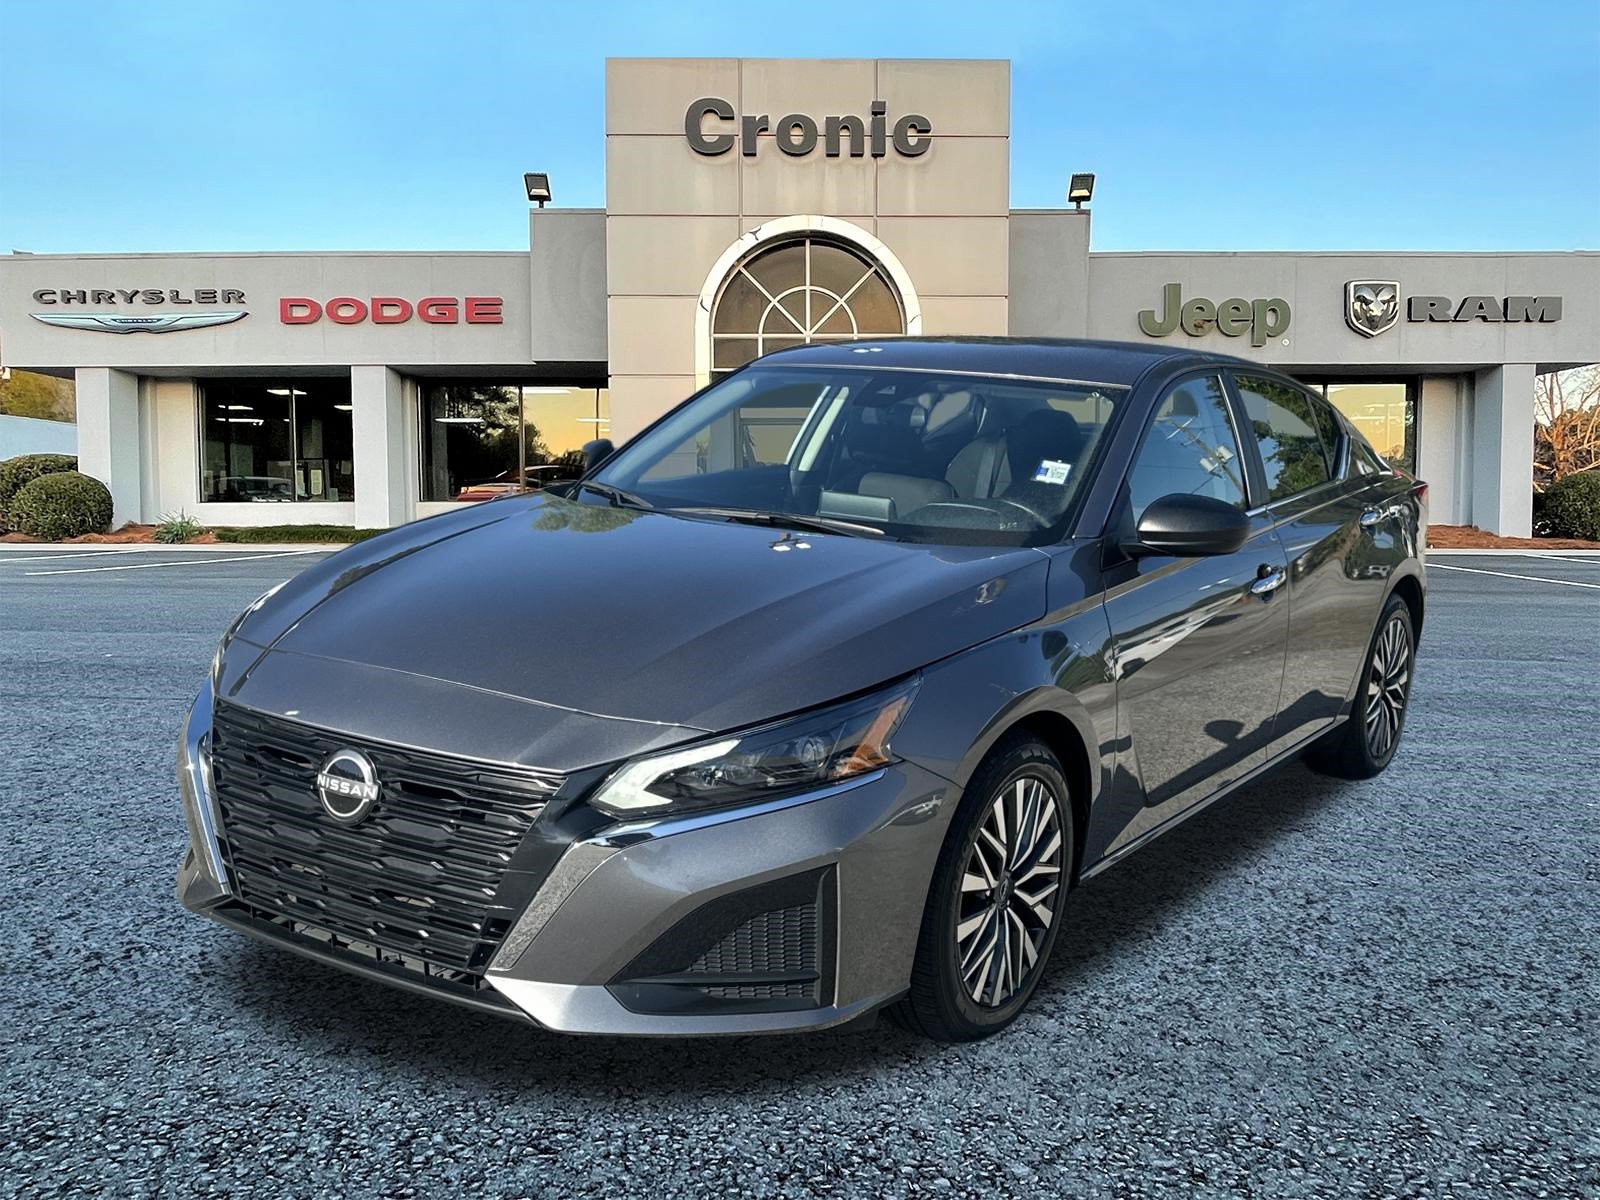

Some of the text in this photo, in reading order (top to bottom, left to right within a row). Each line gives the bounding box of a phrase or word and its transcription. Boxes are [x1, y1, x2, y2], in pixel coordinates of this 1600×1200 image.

[684, 97, 933, 158] Cronic
[32, 288, 247, 305] CHRYSLER
[279, 296, 504, 325] DODGE
[1407, 295, 1563, 323] RAM
[1137, 282, 1292, 347] Jeep
[317, 774, 378, 800] NISSAN
